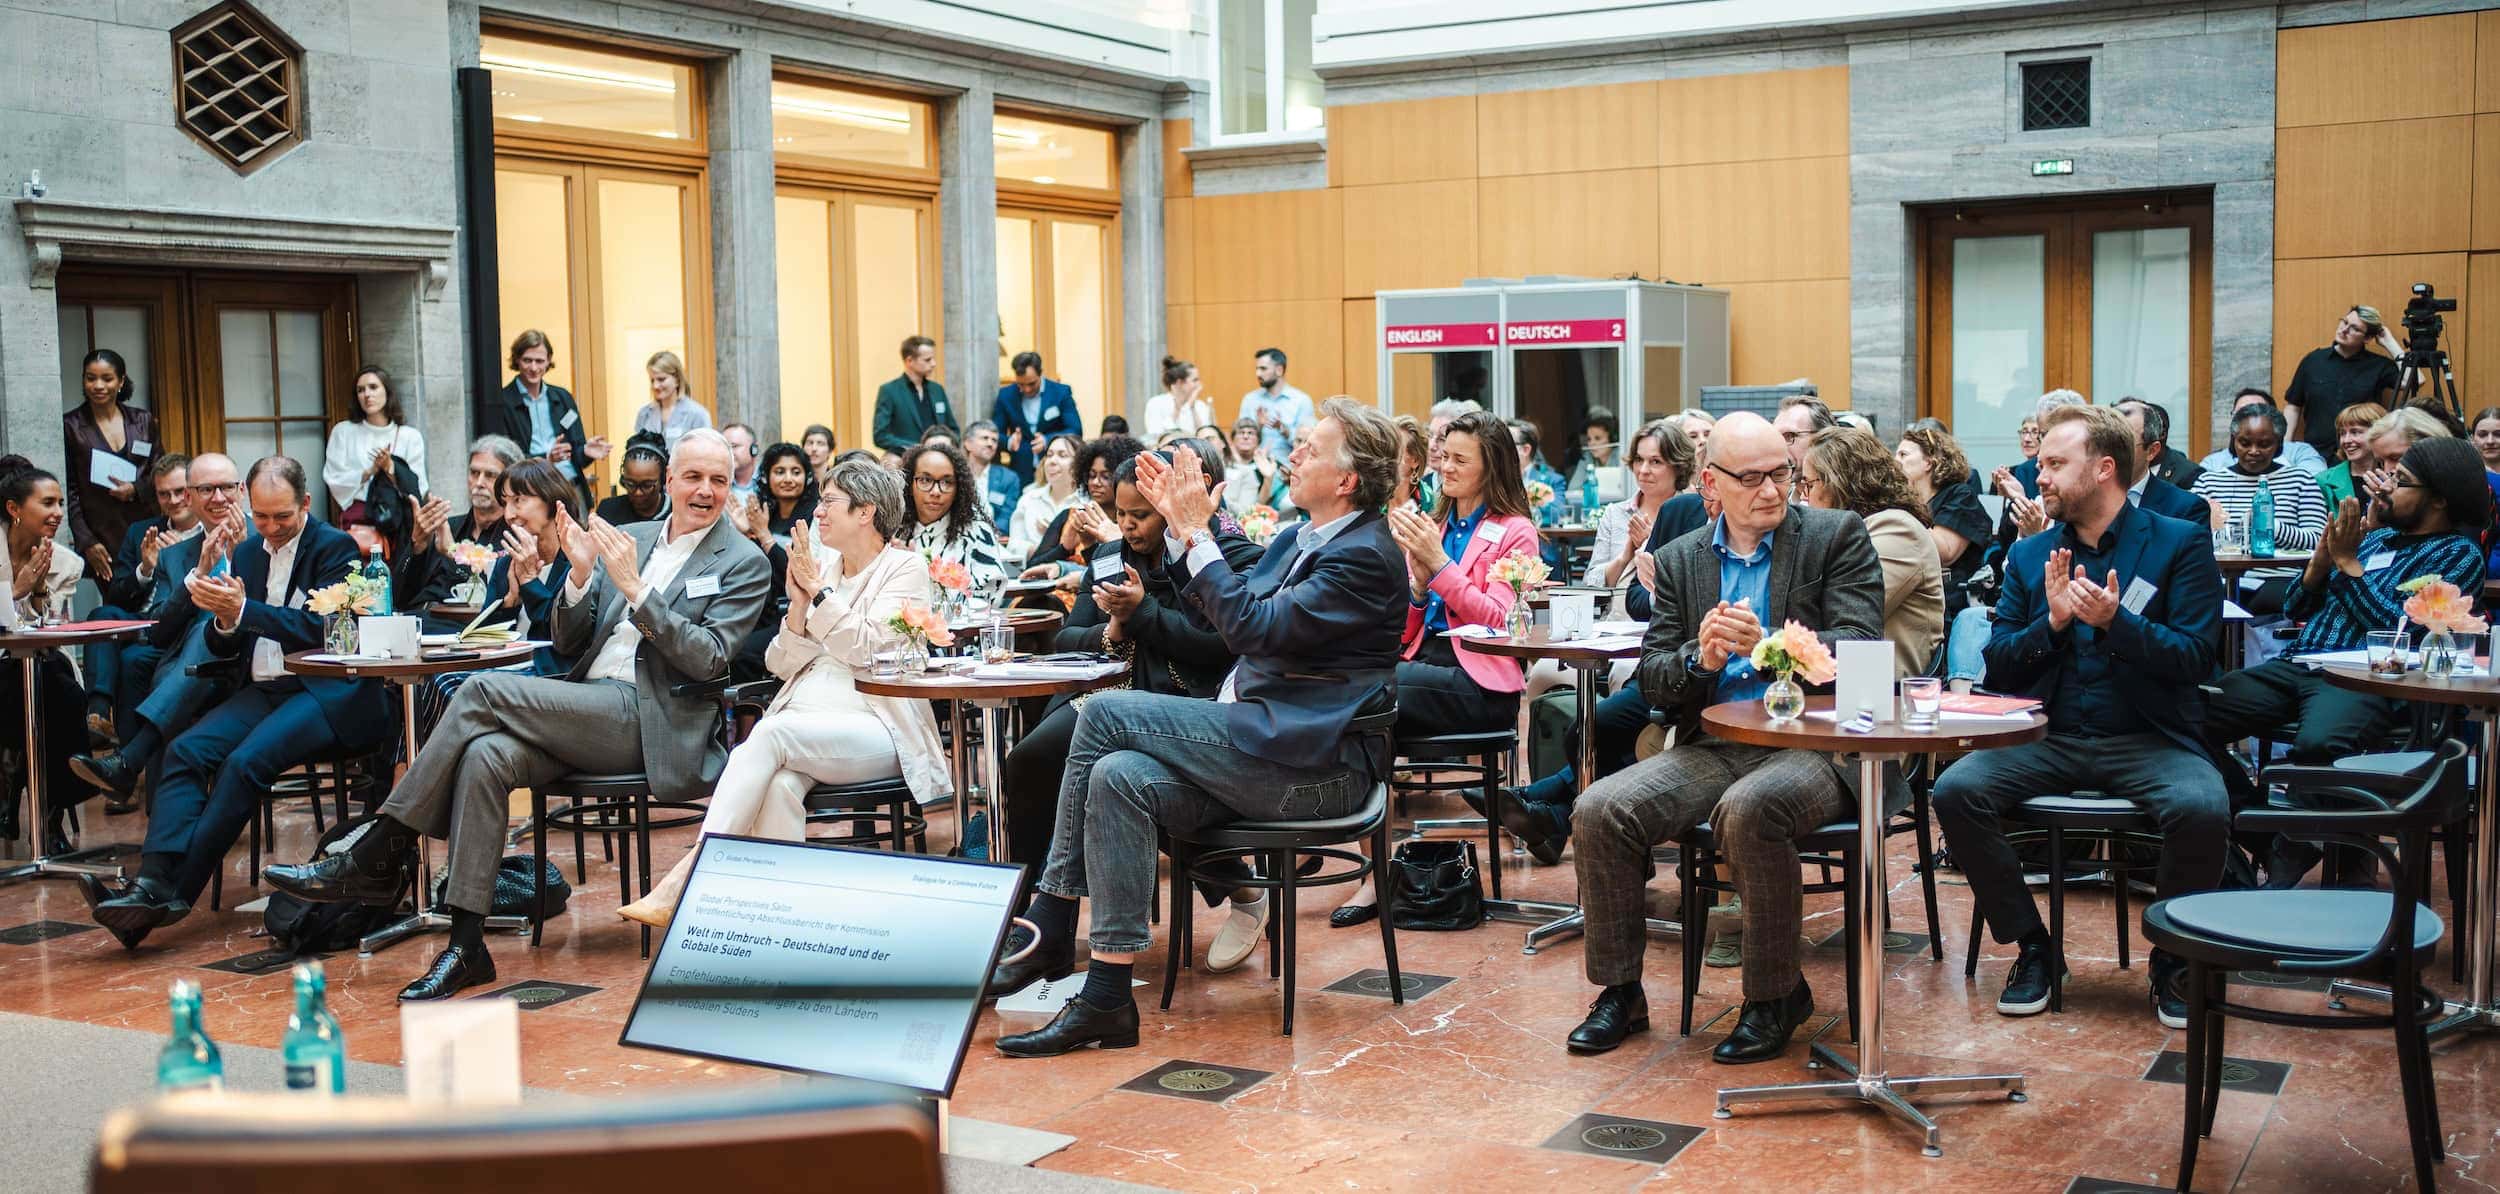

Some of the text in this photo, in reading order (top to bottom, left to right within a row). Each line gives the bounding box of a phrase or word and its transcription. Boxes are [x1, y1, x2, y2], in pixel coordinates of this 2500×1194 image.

[1387, 328, 1495, 344] ENGLISH 1
[1508, 324, 1622, 340] DEUTSCH 2
[726, 854, 776, 866] Global Perspectives
[700, 893, 793, 913] Global Perspectives Salon
[695, 906, 890, 937] Veröffentlichung Abschlussbericht der Kommission
[681, 939, 752, 958] Globale Süden
[687, 925, 710, 938] Welt
[711, 929, 724, 940] im
[726, 931, 772, 947] Umbruch
[782, 938, 848, 957] Deutschland
[849, 947, 869, 959] und
[871, 950, 891, 961] der
[670, 966, 740, 986] Empfehlungen
[798, 1000, 812, 1011] zu
[813, 1000, 832, 1014] den
